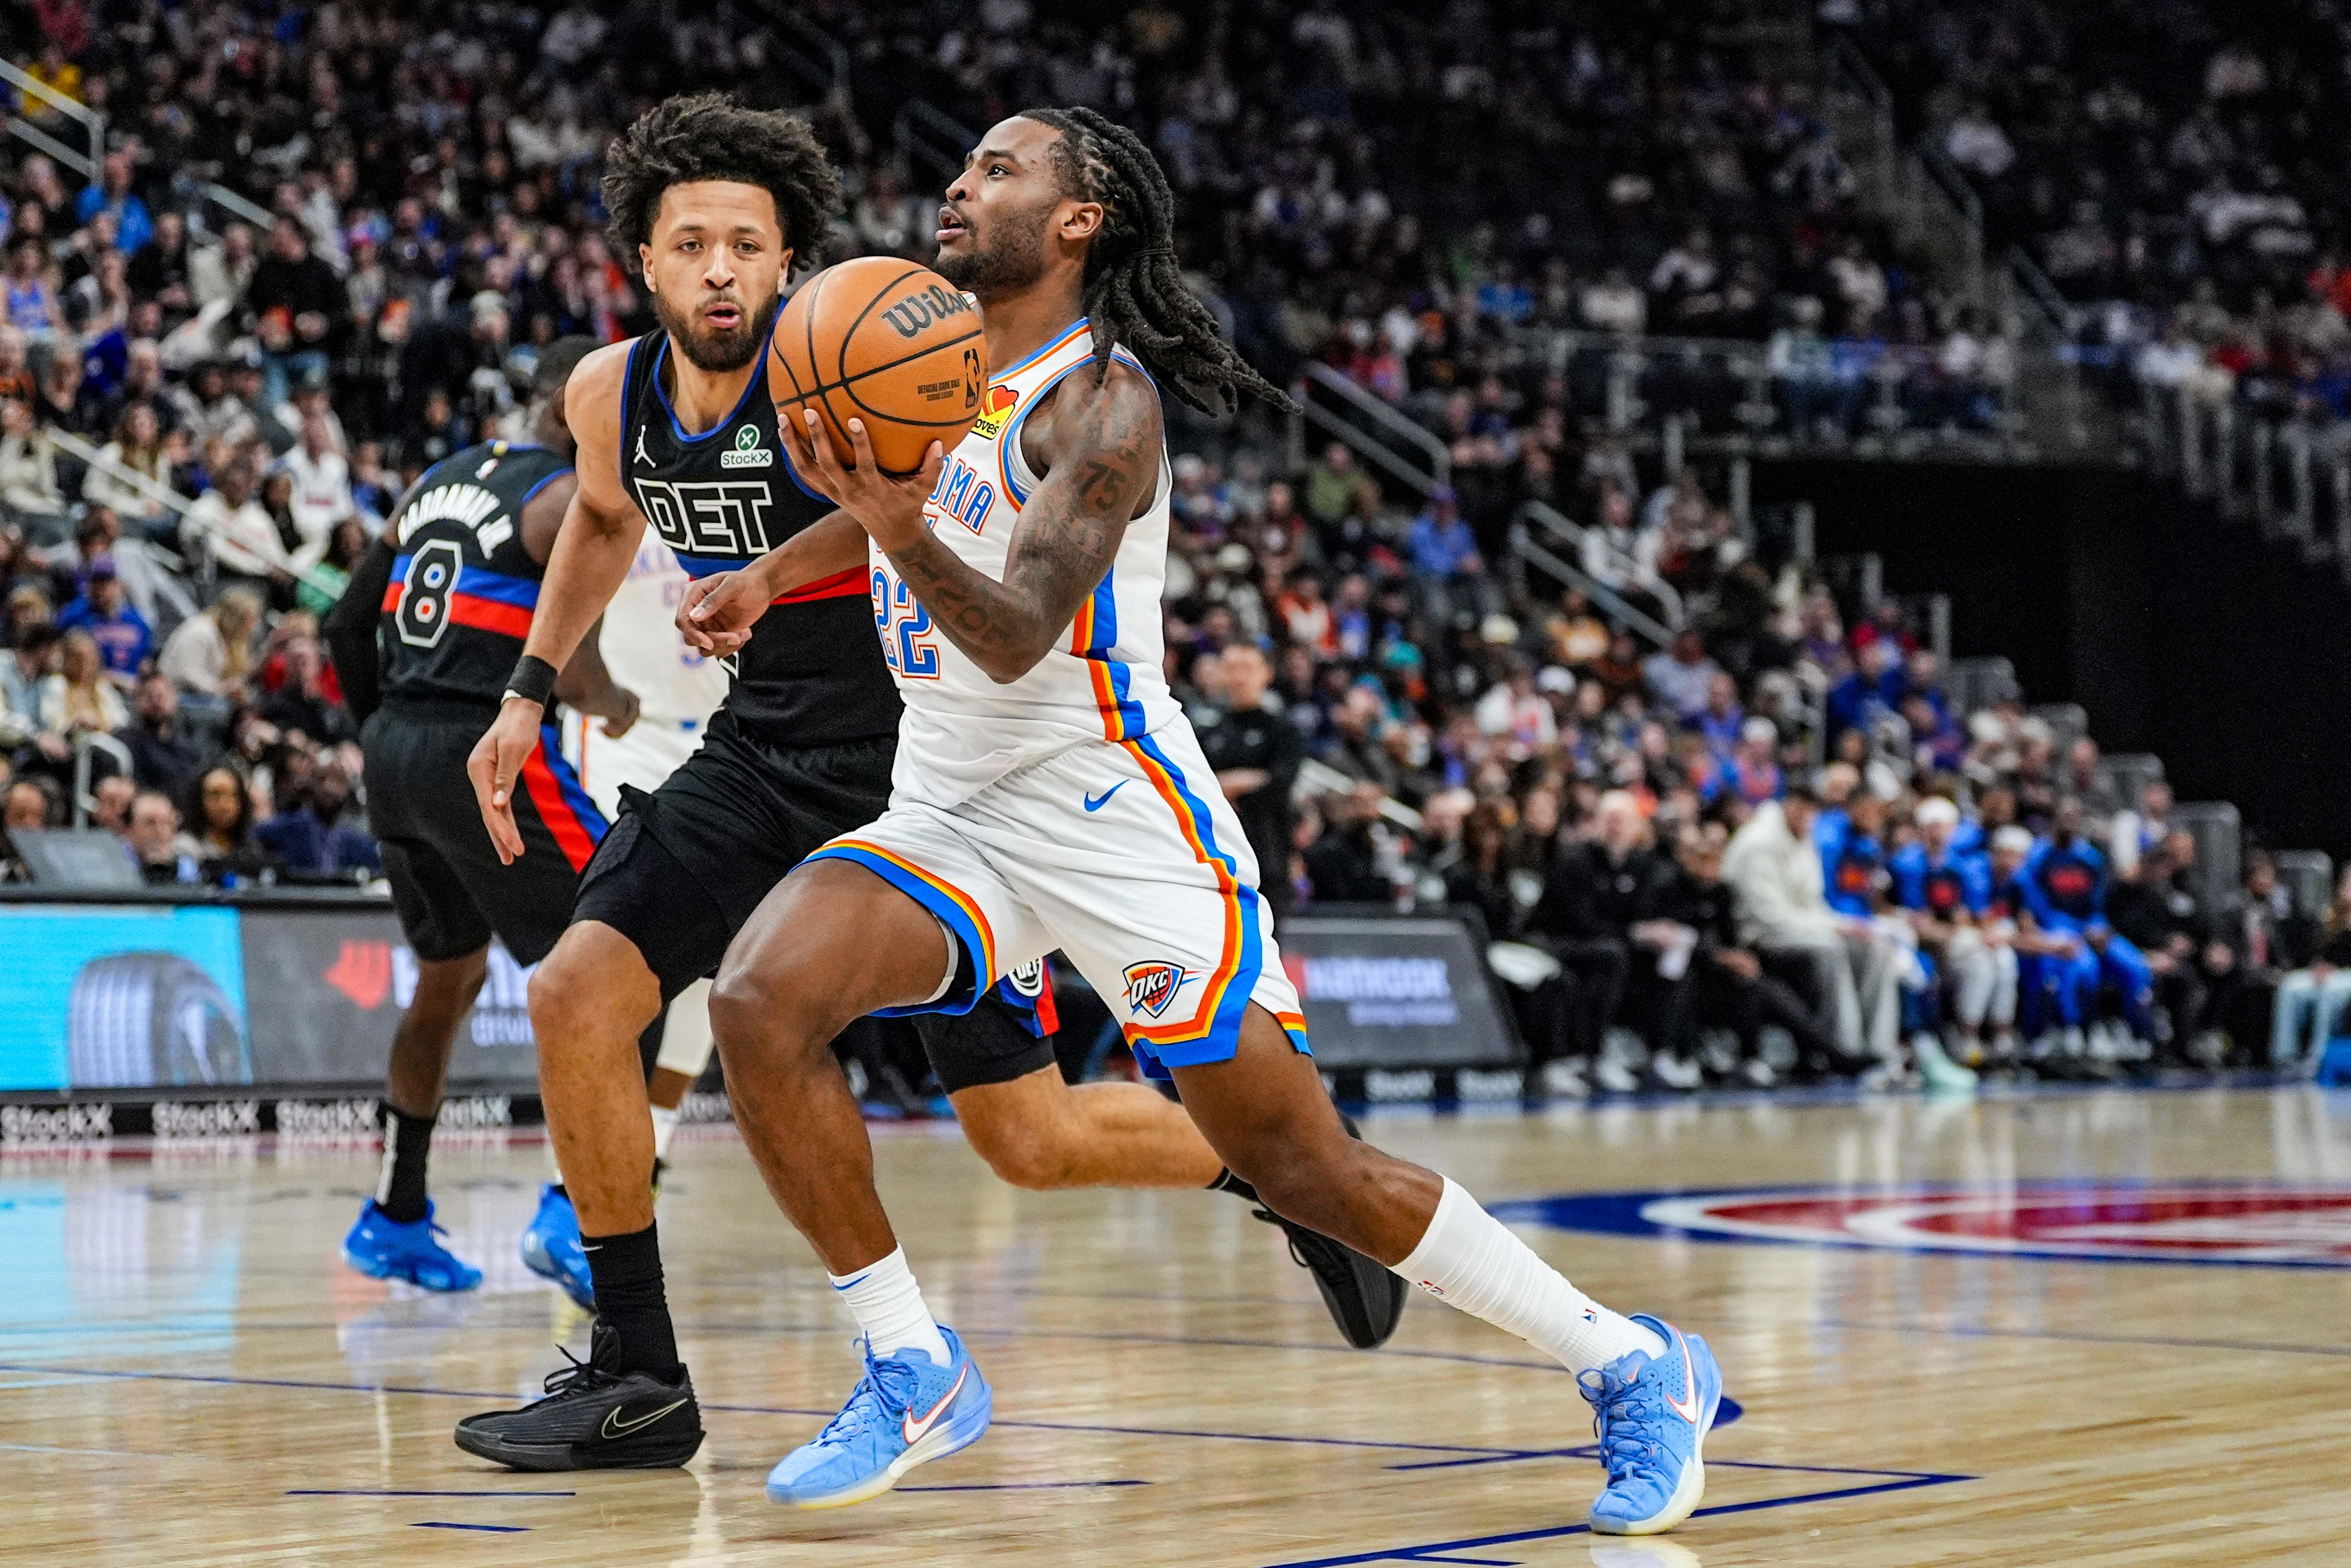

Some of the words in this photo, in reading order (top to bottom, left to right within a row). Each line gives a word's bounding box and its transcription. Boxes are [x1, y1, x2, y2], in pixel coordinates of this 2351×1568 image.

[722, 451, 769, 465] StockX
[927, 453, 996, 536] OMA
[634, 477, 772, 555] DET
[395, 538, 463, 648] 8
[871, 566, 940, 680] 22
[1130, 970, 1169, 1007] OKC
[0, 1105, 112, 1140] StockX
[152, 1102, 258, 1136] StockX
[277, 1100, 380, 1133] StockX
